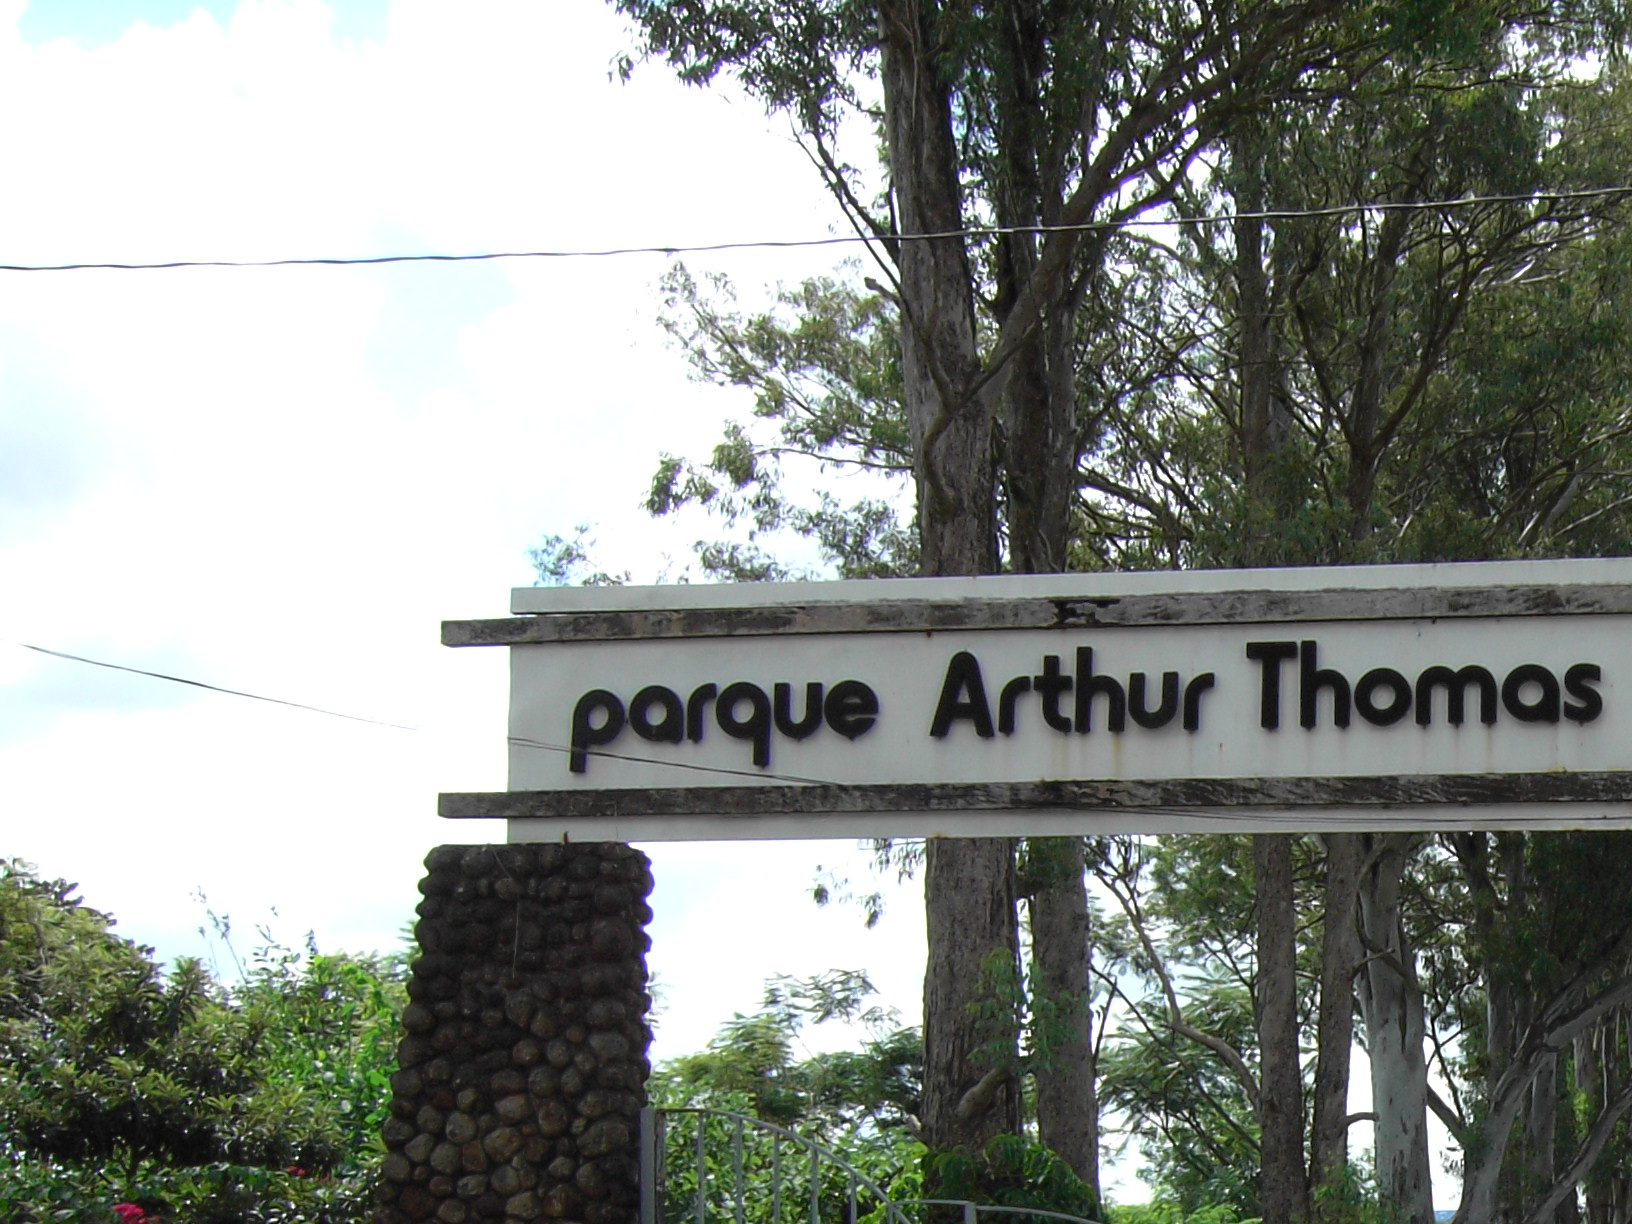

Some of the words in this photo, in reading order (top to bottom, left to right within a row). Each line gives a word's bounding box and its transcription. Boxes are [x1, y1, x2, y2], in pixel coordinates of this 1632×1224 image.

[567, 678, 880, 773] parque
[928, 644, 1216, 739] Arthur
[1245, 639, 1603, 731] Thomas
